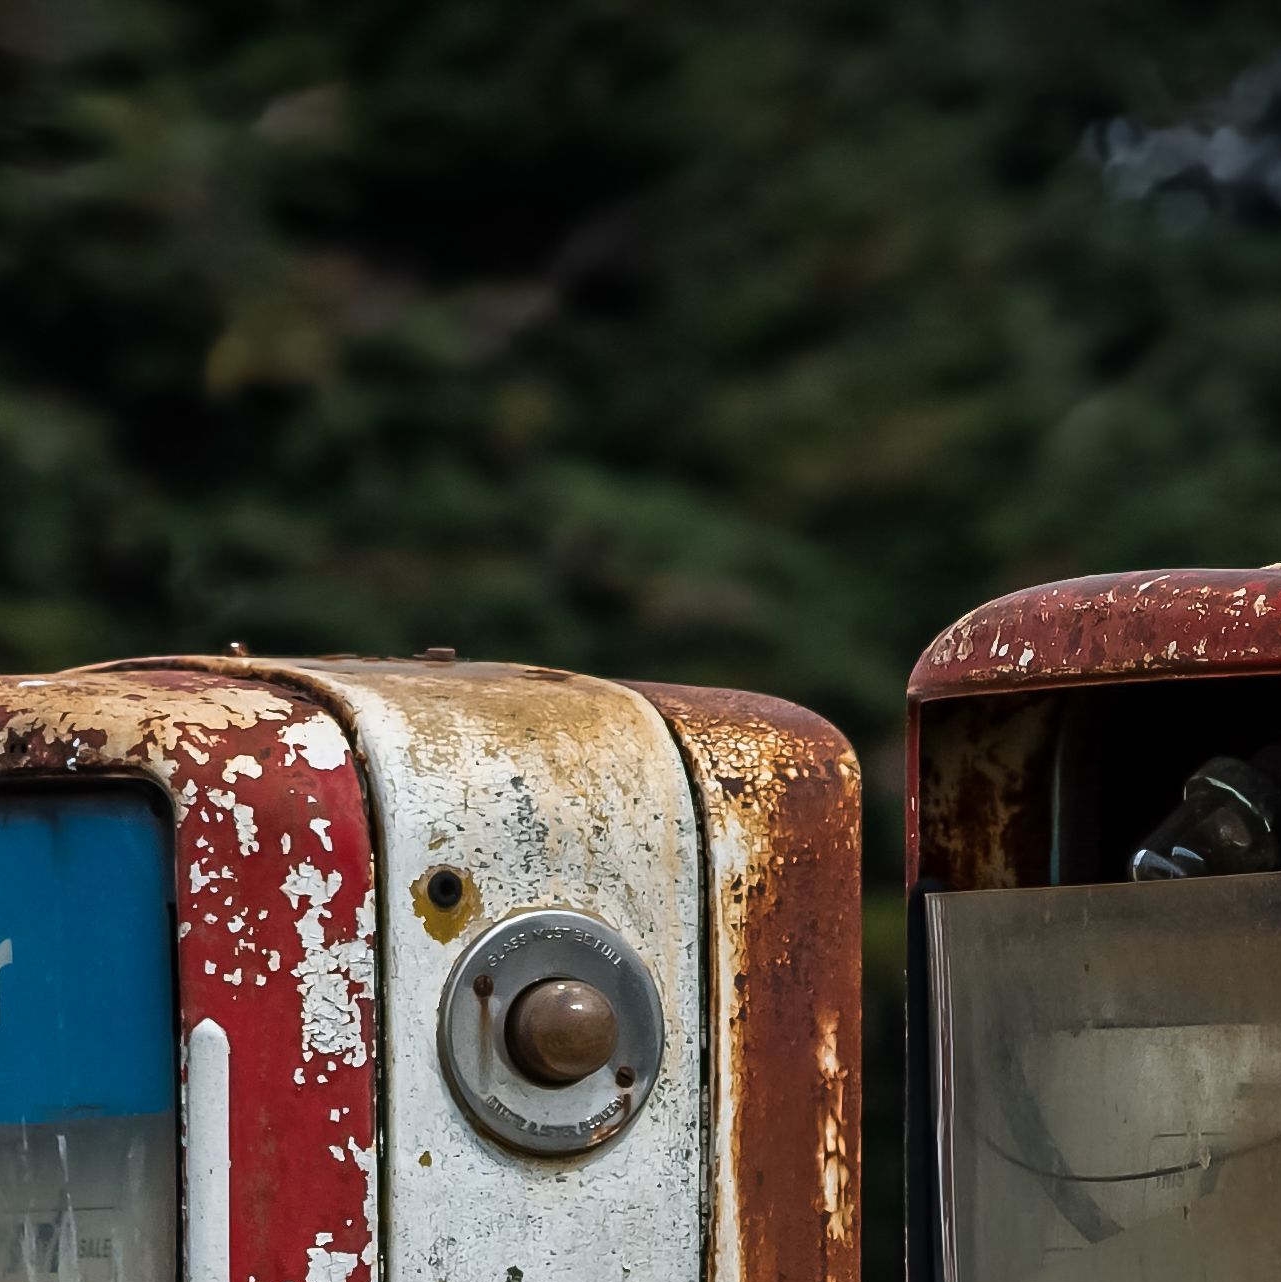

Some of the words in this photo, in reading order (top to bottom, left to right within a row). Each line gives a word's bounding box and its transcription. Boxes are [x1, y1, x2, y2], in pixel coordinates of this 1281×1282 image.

[487, 932, 528, 968] GLASS
[532, 926, 572, 940] MUST
[573, 929, 593, 945] BE
[78, 1238, 112, 1259] SALE
